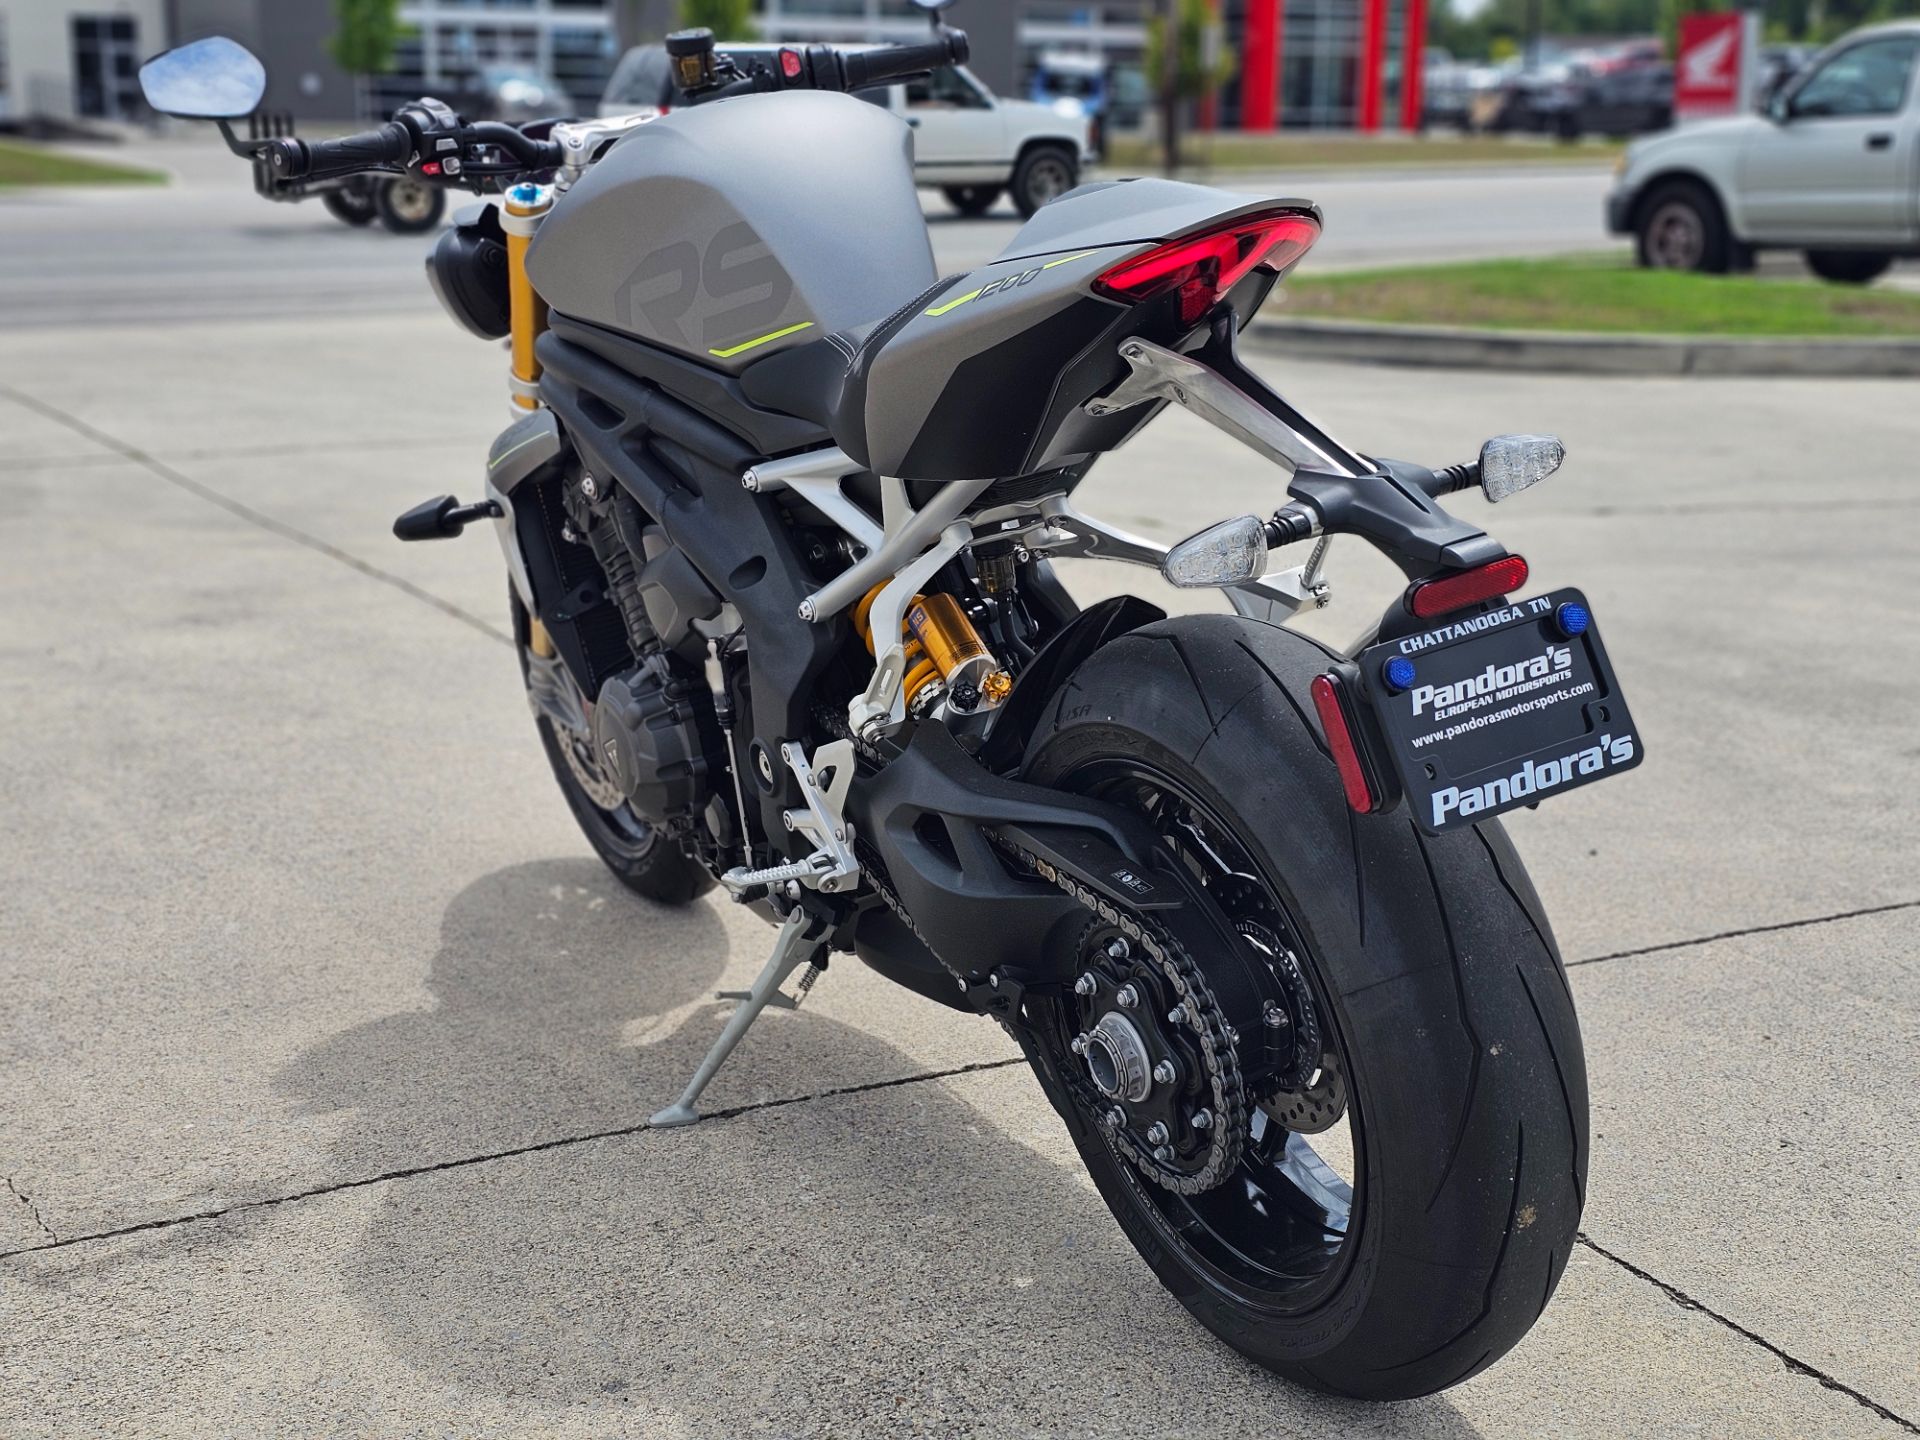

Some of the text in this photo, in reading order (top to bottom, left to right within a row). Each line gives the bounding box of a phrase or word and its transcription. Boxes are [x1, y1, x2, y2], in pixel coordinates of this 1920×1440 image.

[614, 220, 792, 349] RS
[973, 267, 1043, 303] 1200
[1400, 597, 1552, 655] CHATTANOOGA TN
[1411, 646, 1572, 716] Pandora's
[1411, 681, 1595, 748] www.pandorasmotorsports.com
[1434, 668, 1573, 722] EUROPEAN MOTORSPORTS
[1431, 733, 1634, 827] Pandora's
